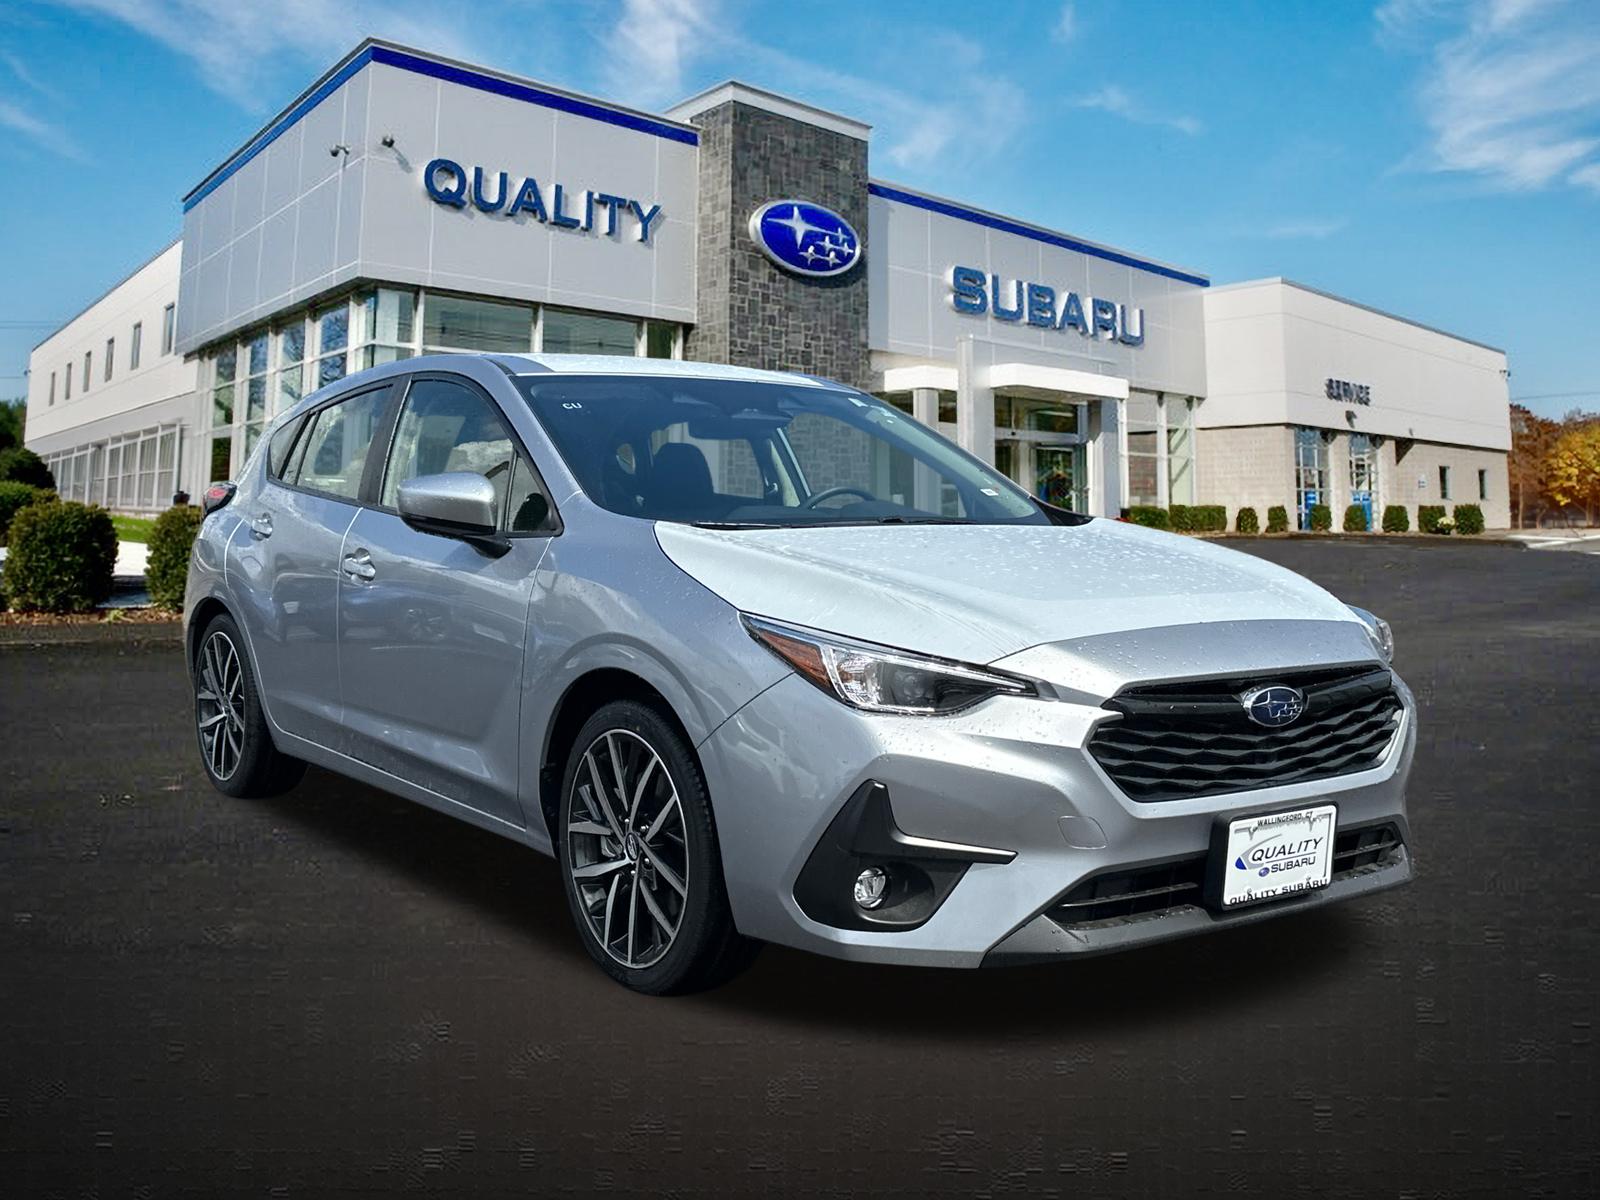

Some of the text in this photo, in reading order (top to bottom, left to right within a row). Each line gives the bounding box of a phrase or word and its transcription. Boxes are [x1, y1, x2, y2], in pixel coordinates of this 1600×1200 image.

[424, 158, 662, 243] QUALITY
[949, 265, 1145, 347] SUBARU
[1251, 837, 1324, 862] QUALITY
[1270, 856, 1316, 874] SUBARU
[1229, 879, 1328, 904] QUALITY SUBARU
